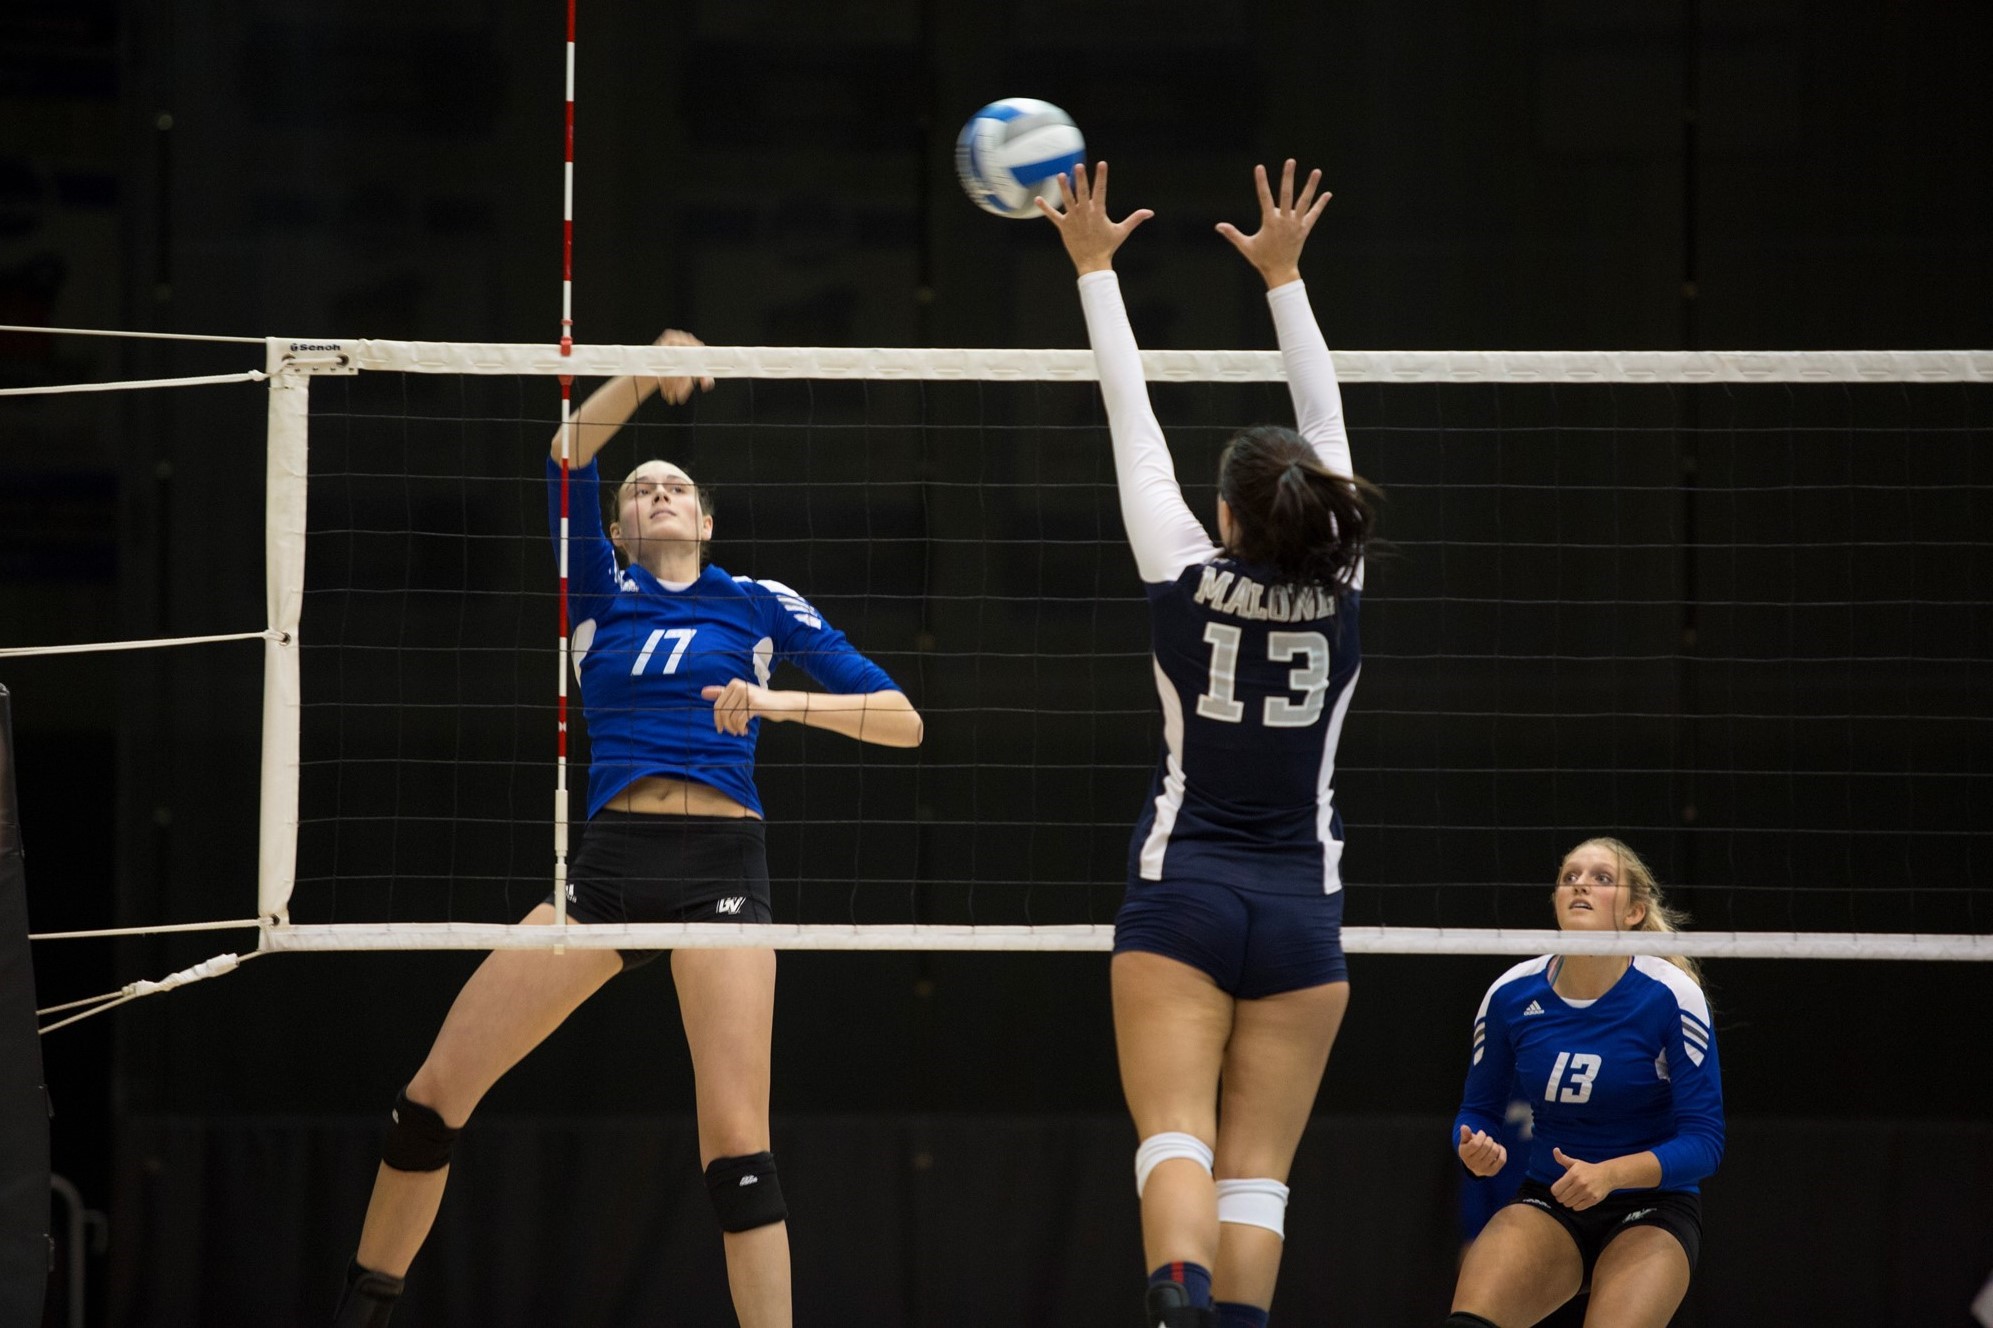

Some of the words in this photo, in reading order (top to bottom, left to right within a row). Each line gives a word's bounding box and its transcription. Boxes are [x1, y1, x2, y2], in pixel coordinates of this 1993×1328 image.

[300, 343, 342, 351] Senoh
[630, 628, 698, 676] 17
[1196, 621, 1330, 727] 13
[1544, 1051, 1602, 1104] 13
